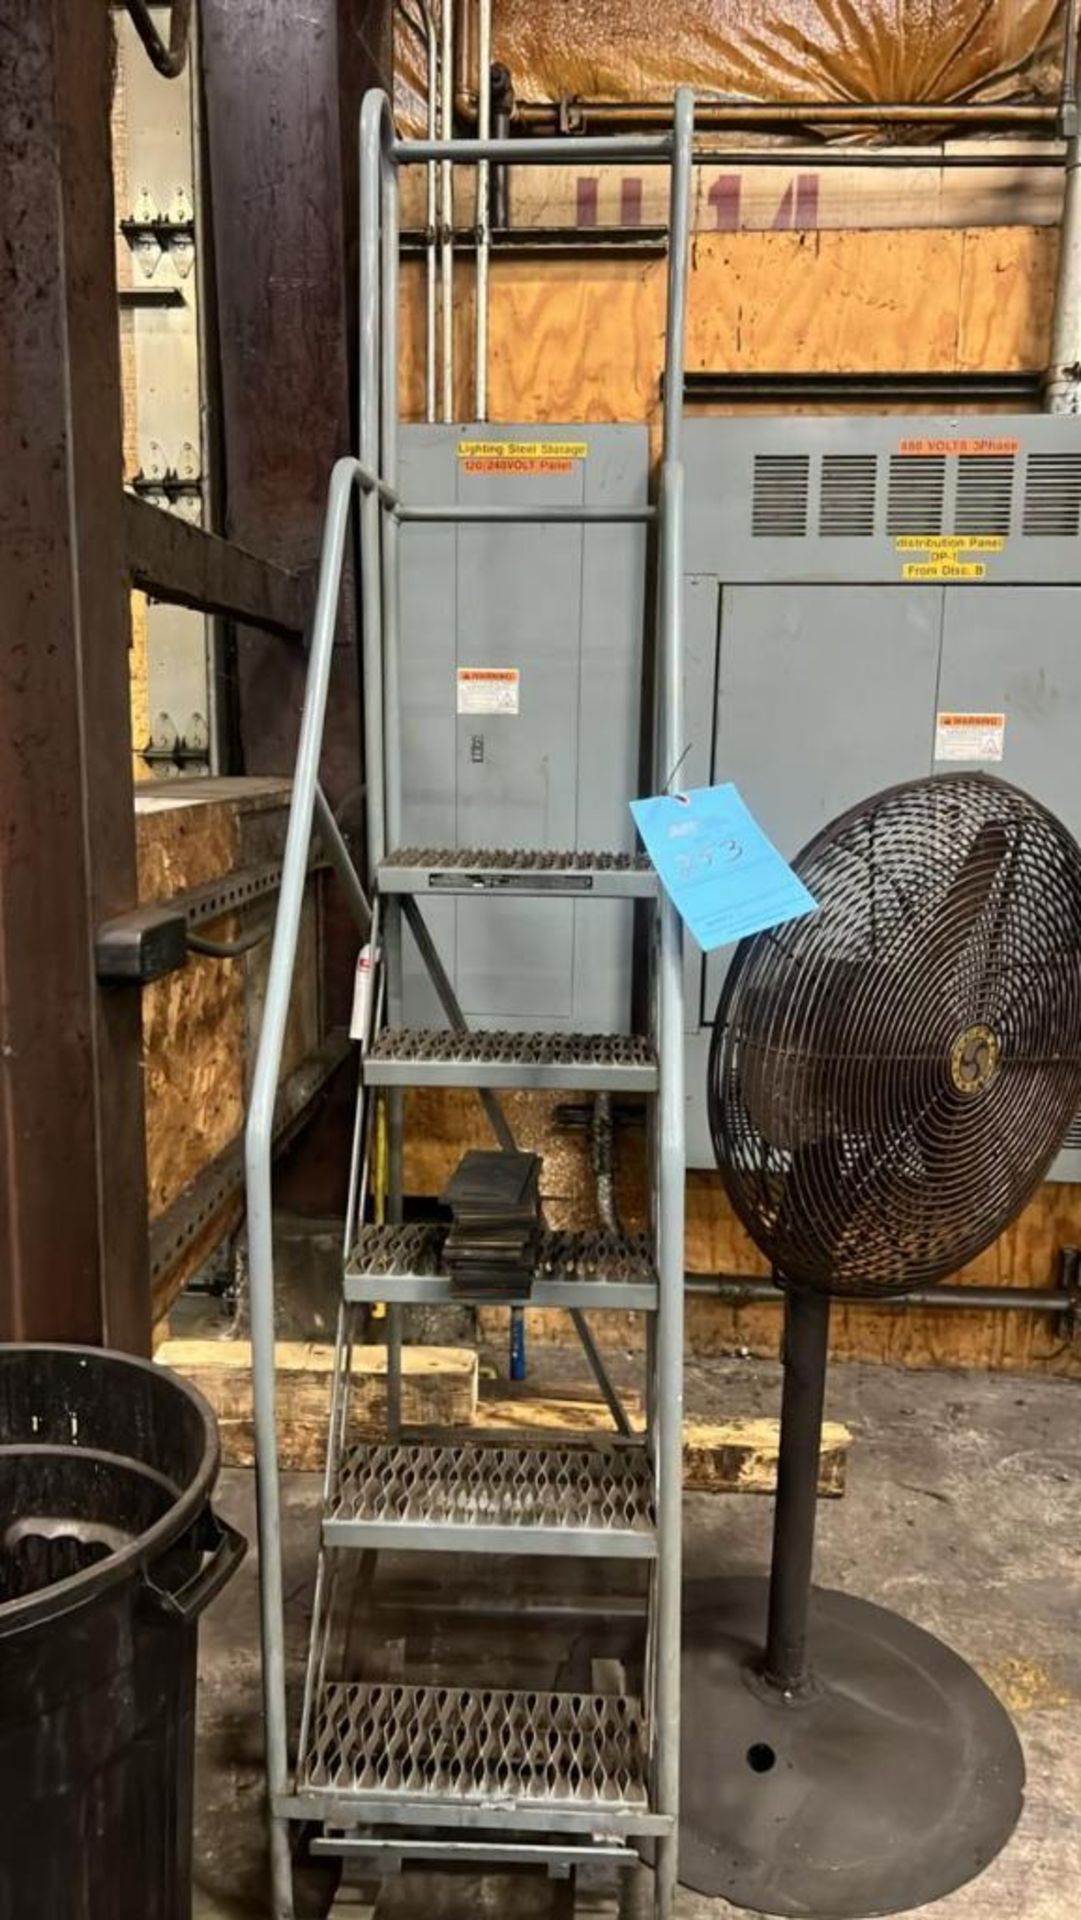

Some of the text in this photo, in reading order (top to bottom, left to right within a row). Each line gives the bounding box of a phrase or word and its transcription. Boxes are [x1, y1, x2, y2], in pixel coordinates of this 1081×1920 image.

[458, 443, 586, 458] Lighting Steel Storage
[928, 439, 968, 451] VOLTS
[540, 459, 572, 472] Panel
[896, 536, 965, 548] distribution
[930, 551, 957, 562] DP-1
[907, 565, 938, 576] From
[952, 715, 998, 726] WARNING
